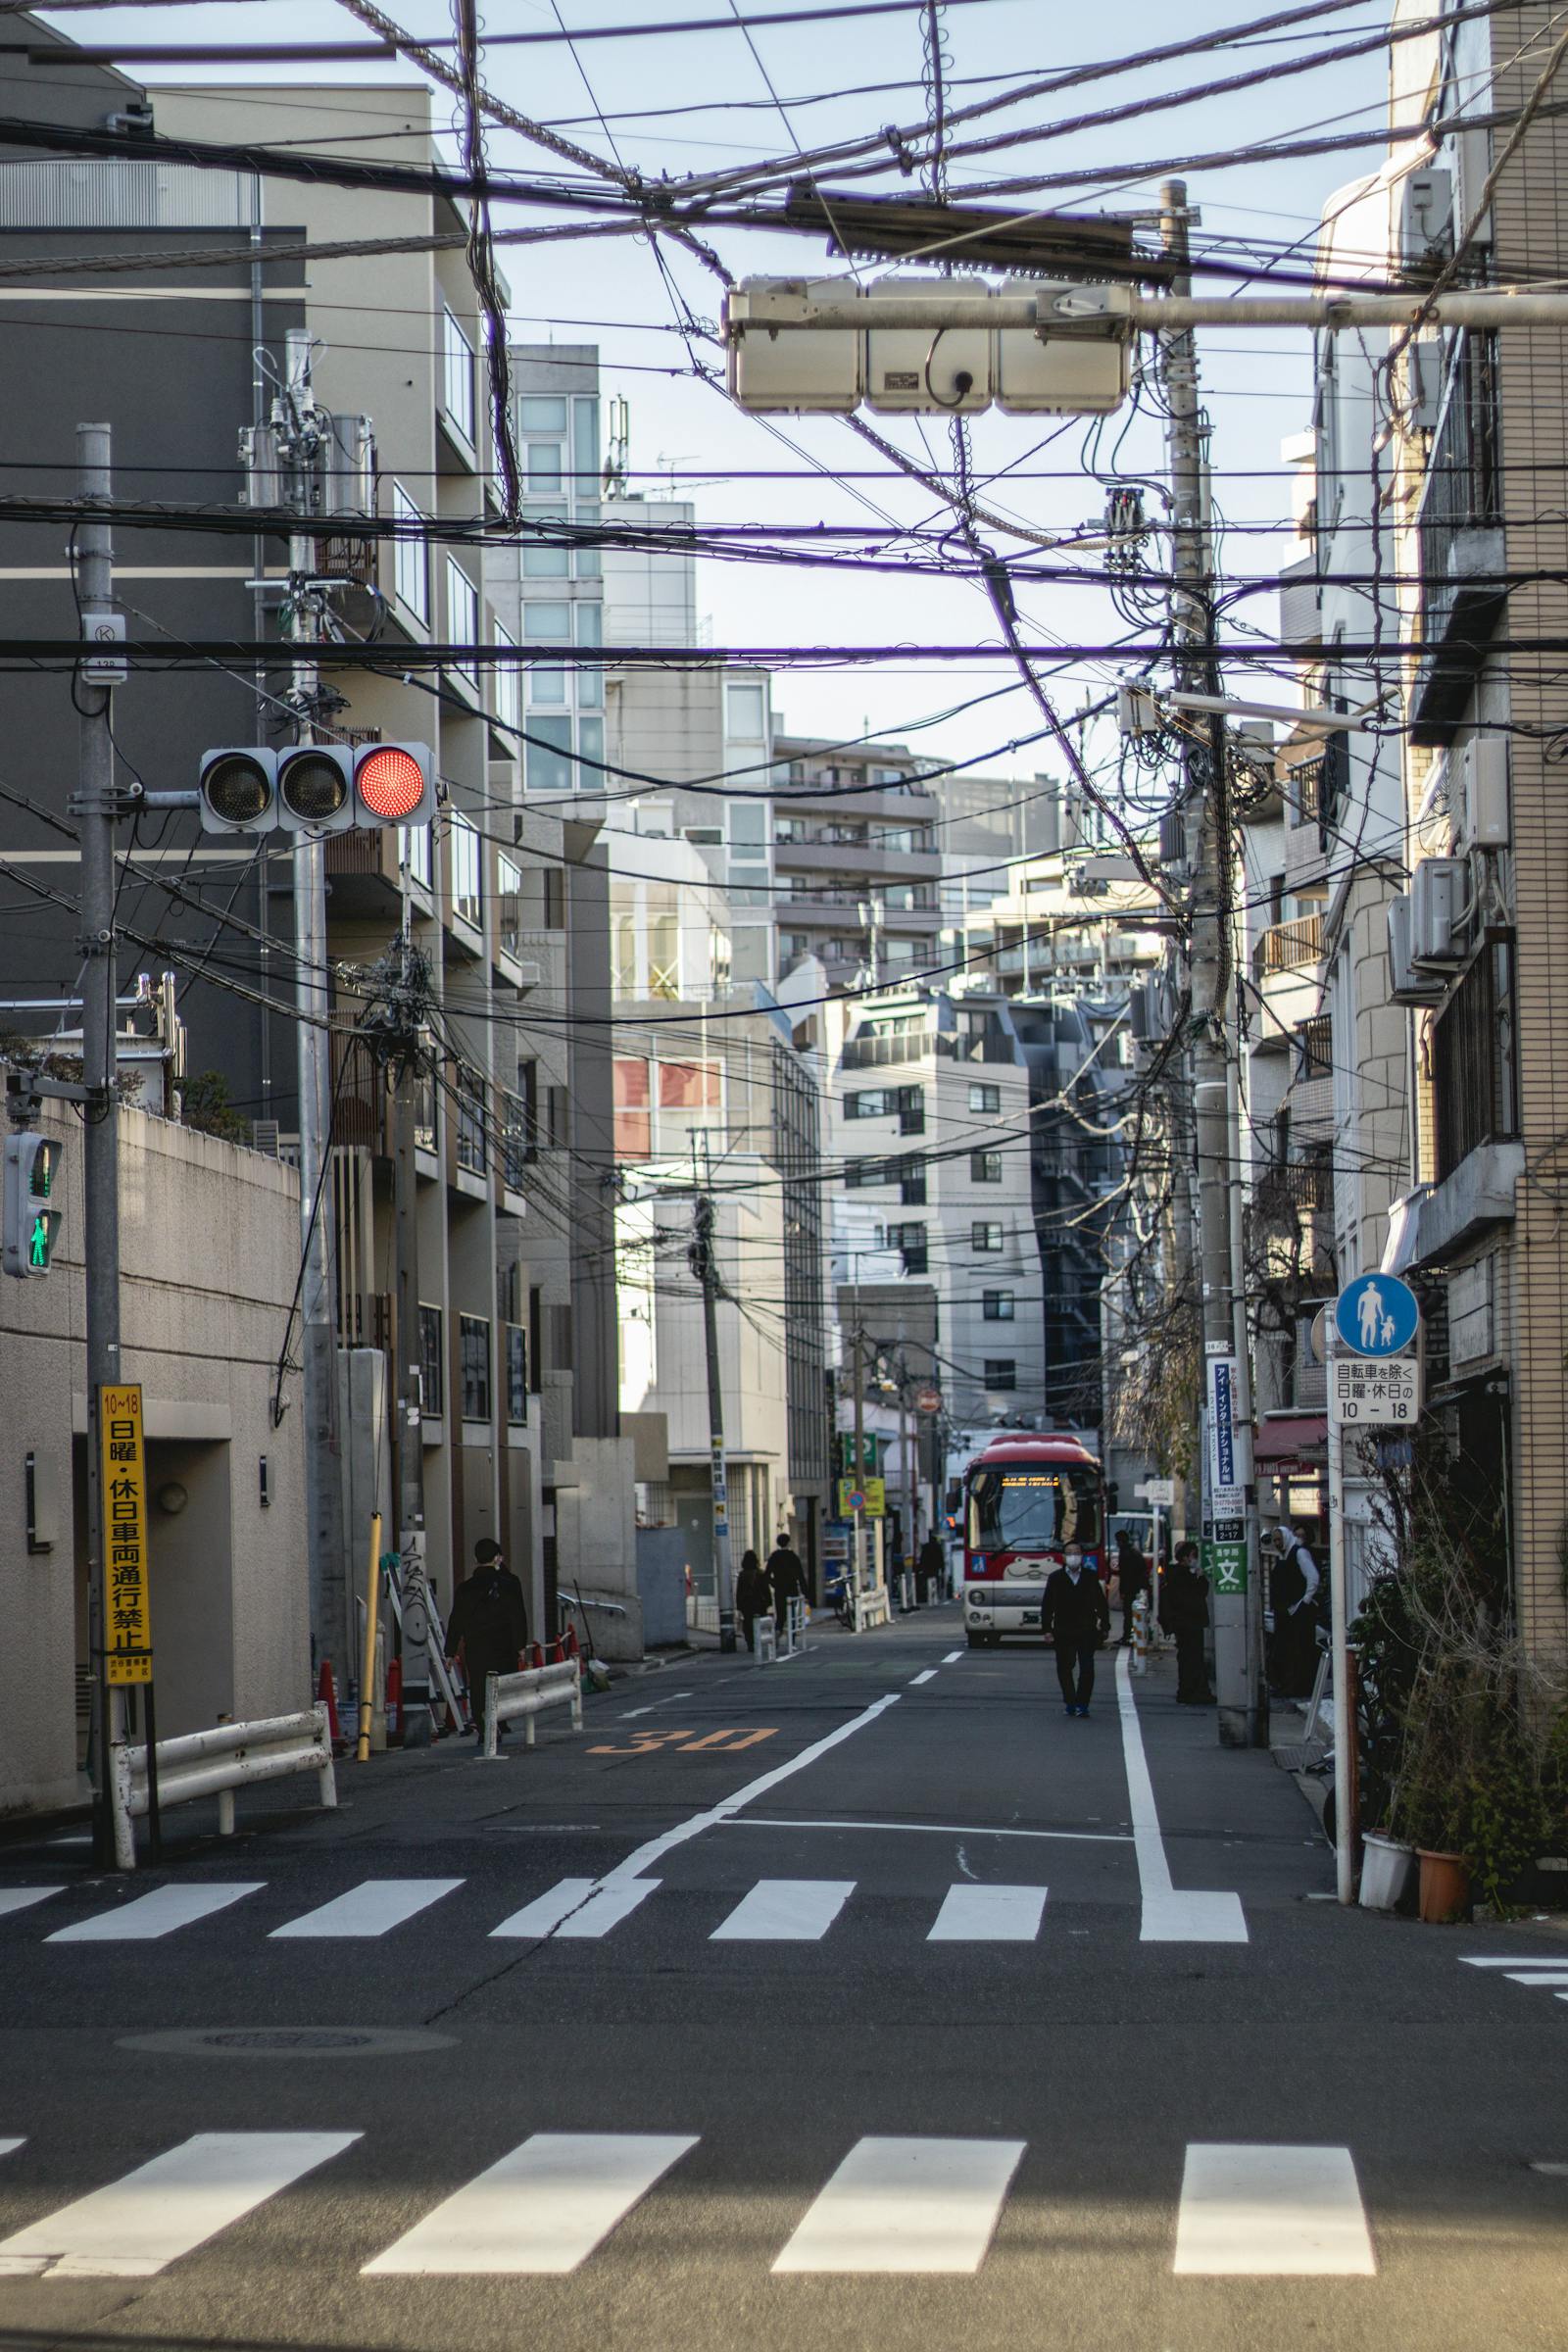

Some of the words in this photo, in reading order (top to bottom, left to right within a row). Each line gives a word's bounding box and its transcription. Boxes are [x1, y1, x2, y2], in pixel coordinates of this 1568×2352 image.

[1338, 1364, 1412, 1380] 自転車を除く
[1338, 1383, 1412, 1399] 日曜・休日の
[1342, 1402, 1358, 1418] 10
[1392, 1402, 1407, 1418] 18
[110, 1421, 144, 1650] 日曜・休日車両通行禁止
[1217, 1558, 1240, 1586] 文
[585, 1728, 780, 1754] 30
